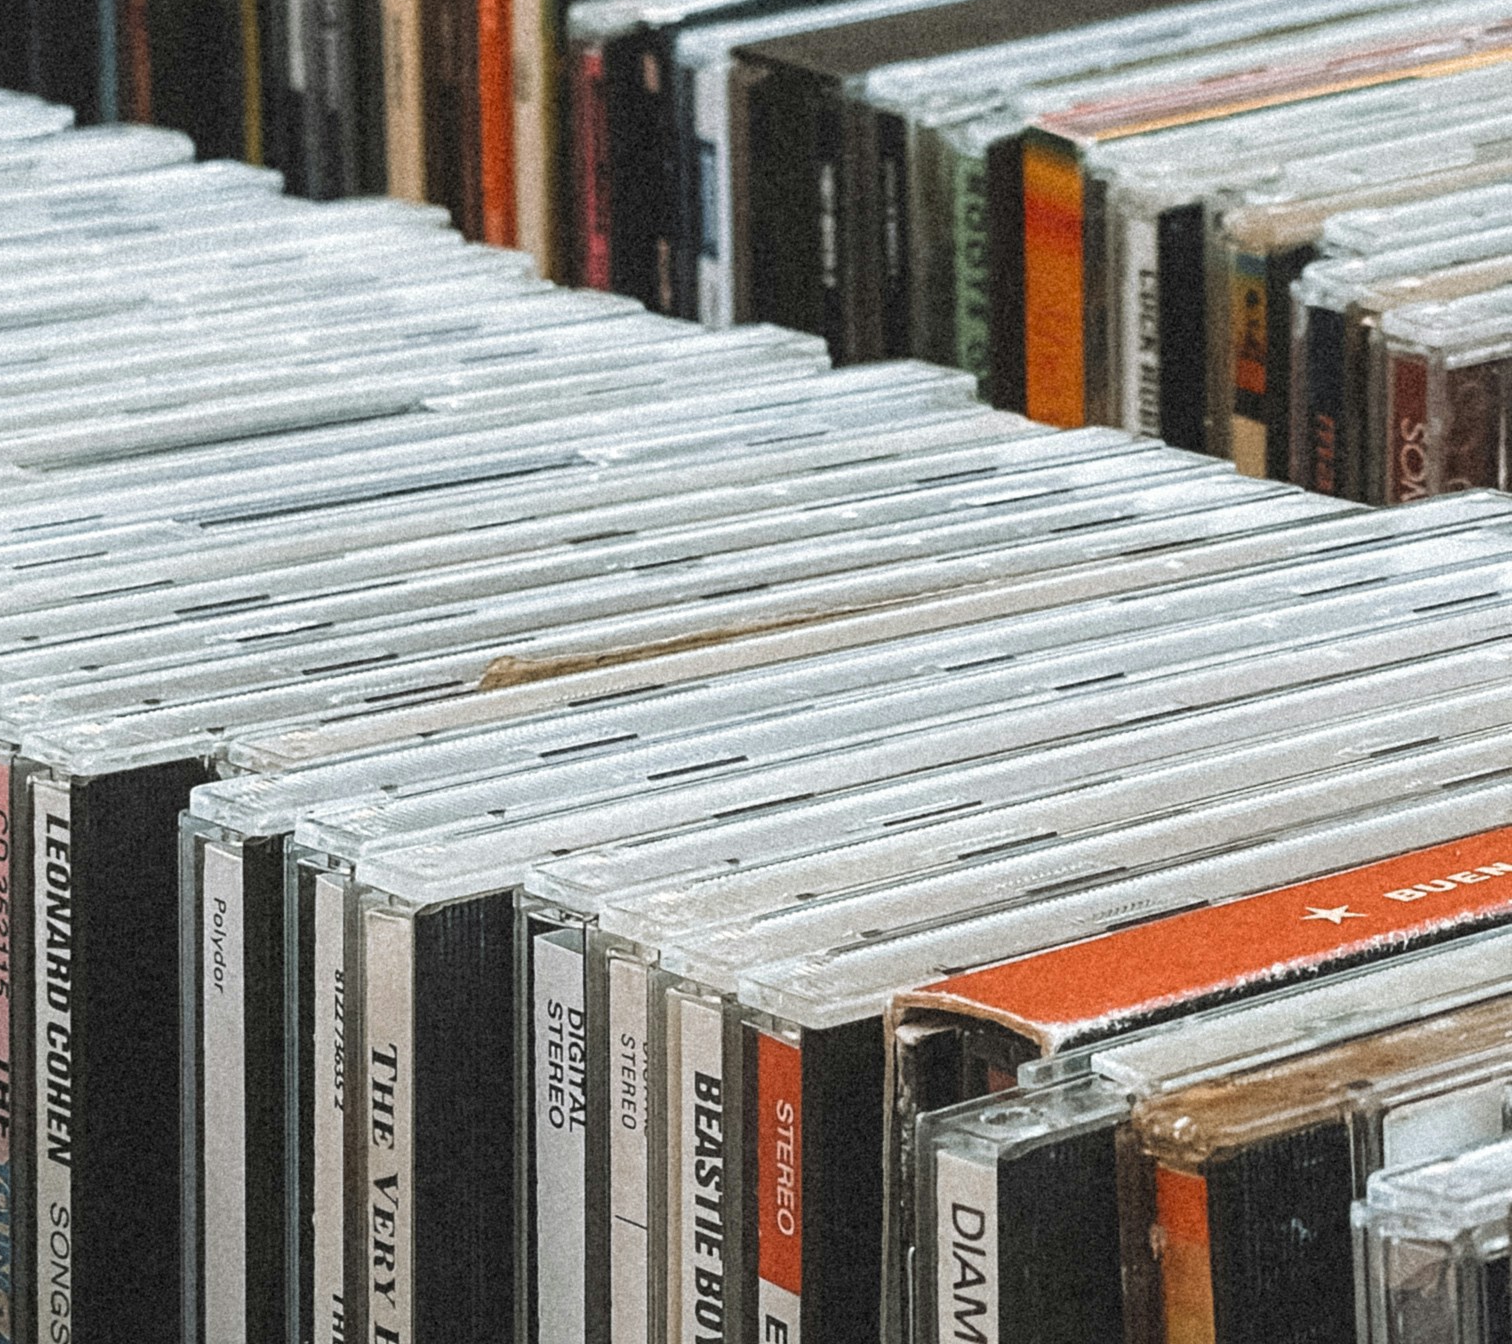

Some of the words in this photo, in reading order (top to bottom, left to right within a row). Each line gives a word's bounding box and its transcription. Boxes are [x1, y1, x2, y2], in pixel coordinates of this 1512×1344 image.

[44, 813, 72, 1035] LEONARD
[210, 896, 228, 993] Polydor
[1383, 861, 1512, 902] BUEN
[44, 1040, 72, 1167] COHEN
[368, 1042, 398, 1149] THE
[546, 999, 564, 1130] STEREO
[567, 1008, 586, 1134] DIGITAL
[621, 1033, 637, 1131] STEREO
[695, 1073, 723, 1270] BEASTIE
[776, 1098, 794, 1236] STEREO
[370, 1171, 400, 1309] VERY
